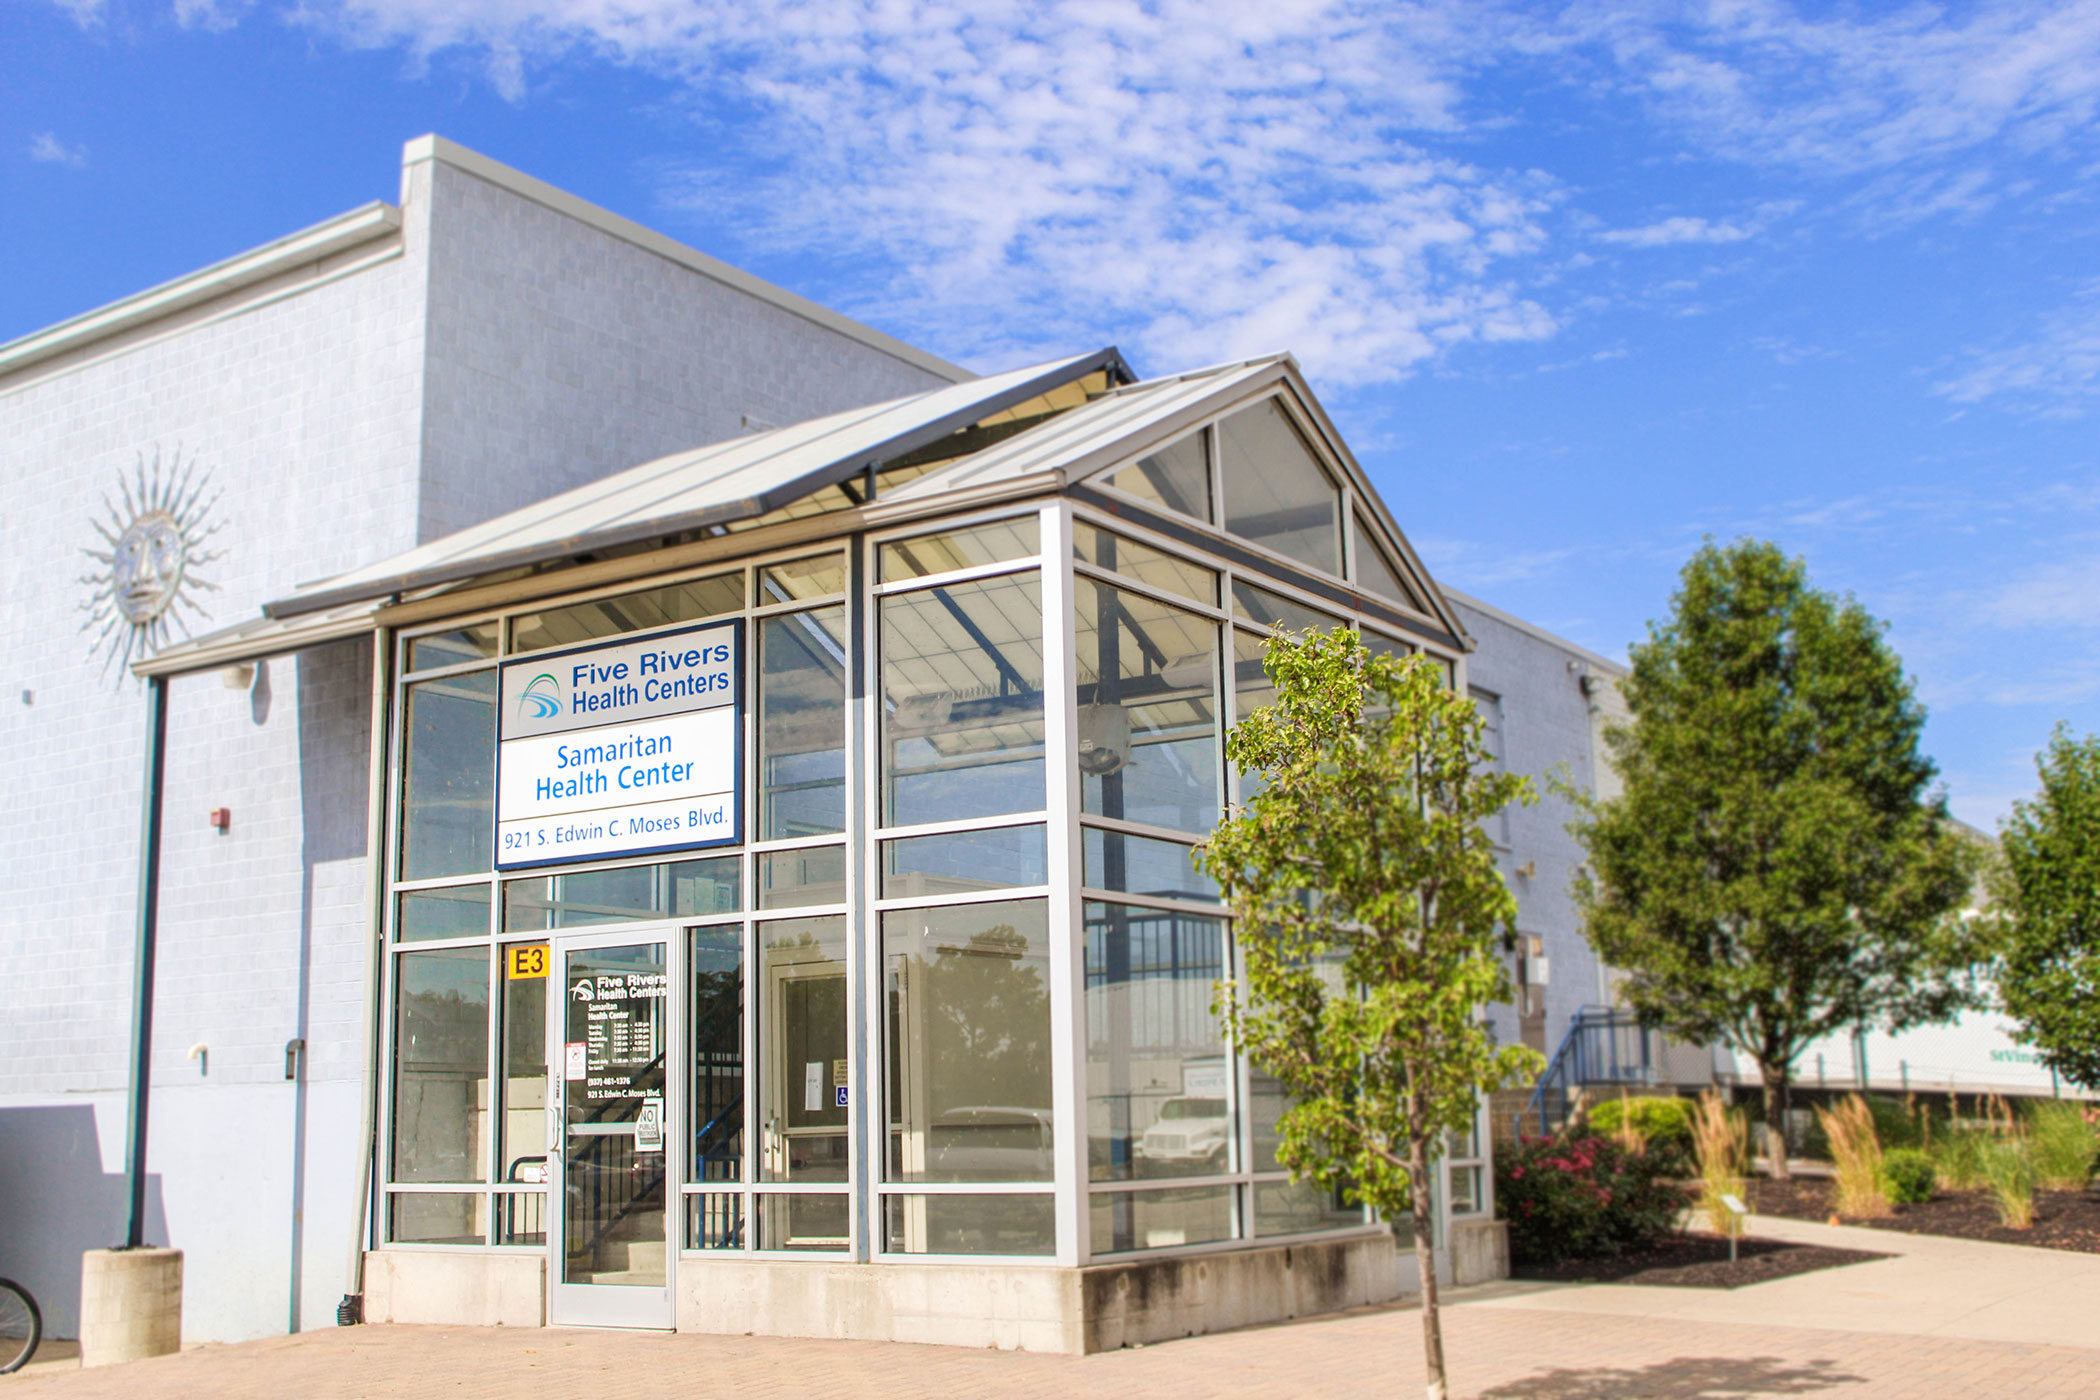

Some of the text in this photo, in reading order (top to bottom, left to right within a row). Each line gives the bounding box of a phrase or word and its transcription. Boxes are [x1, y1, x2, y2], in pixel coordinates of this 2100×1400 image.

[573, 644, 729, 687] Five Rivers
[573, 671, 729, 714] Health Centers
[557, 734, 672, 769] Samaritan
[536, 761, 694, 801] Health Center
[505, 806, 728, 849] 921 S. Edwin C. Moses Blvd.
[515, 948, 543, 974] E3
[597, 974, 667, 988] Five Rivers
[597, 986, 667, 1000] Health Centers
[588, 1002, 618, 1012] Samaritan
[588, 1011, 630, 1020] Health Center
[604, 1090, 621, 1098] Edwin
[628, 1089, 646, 1097] Moses
[641, 1110, 654, 1122] NO
